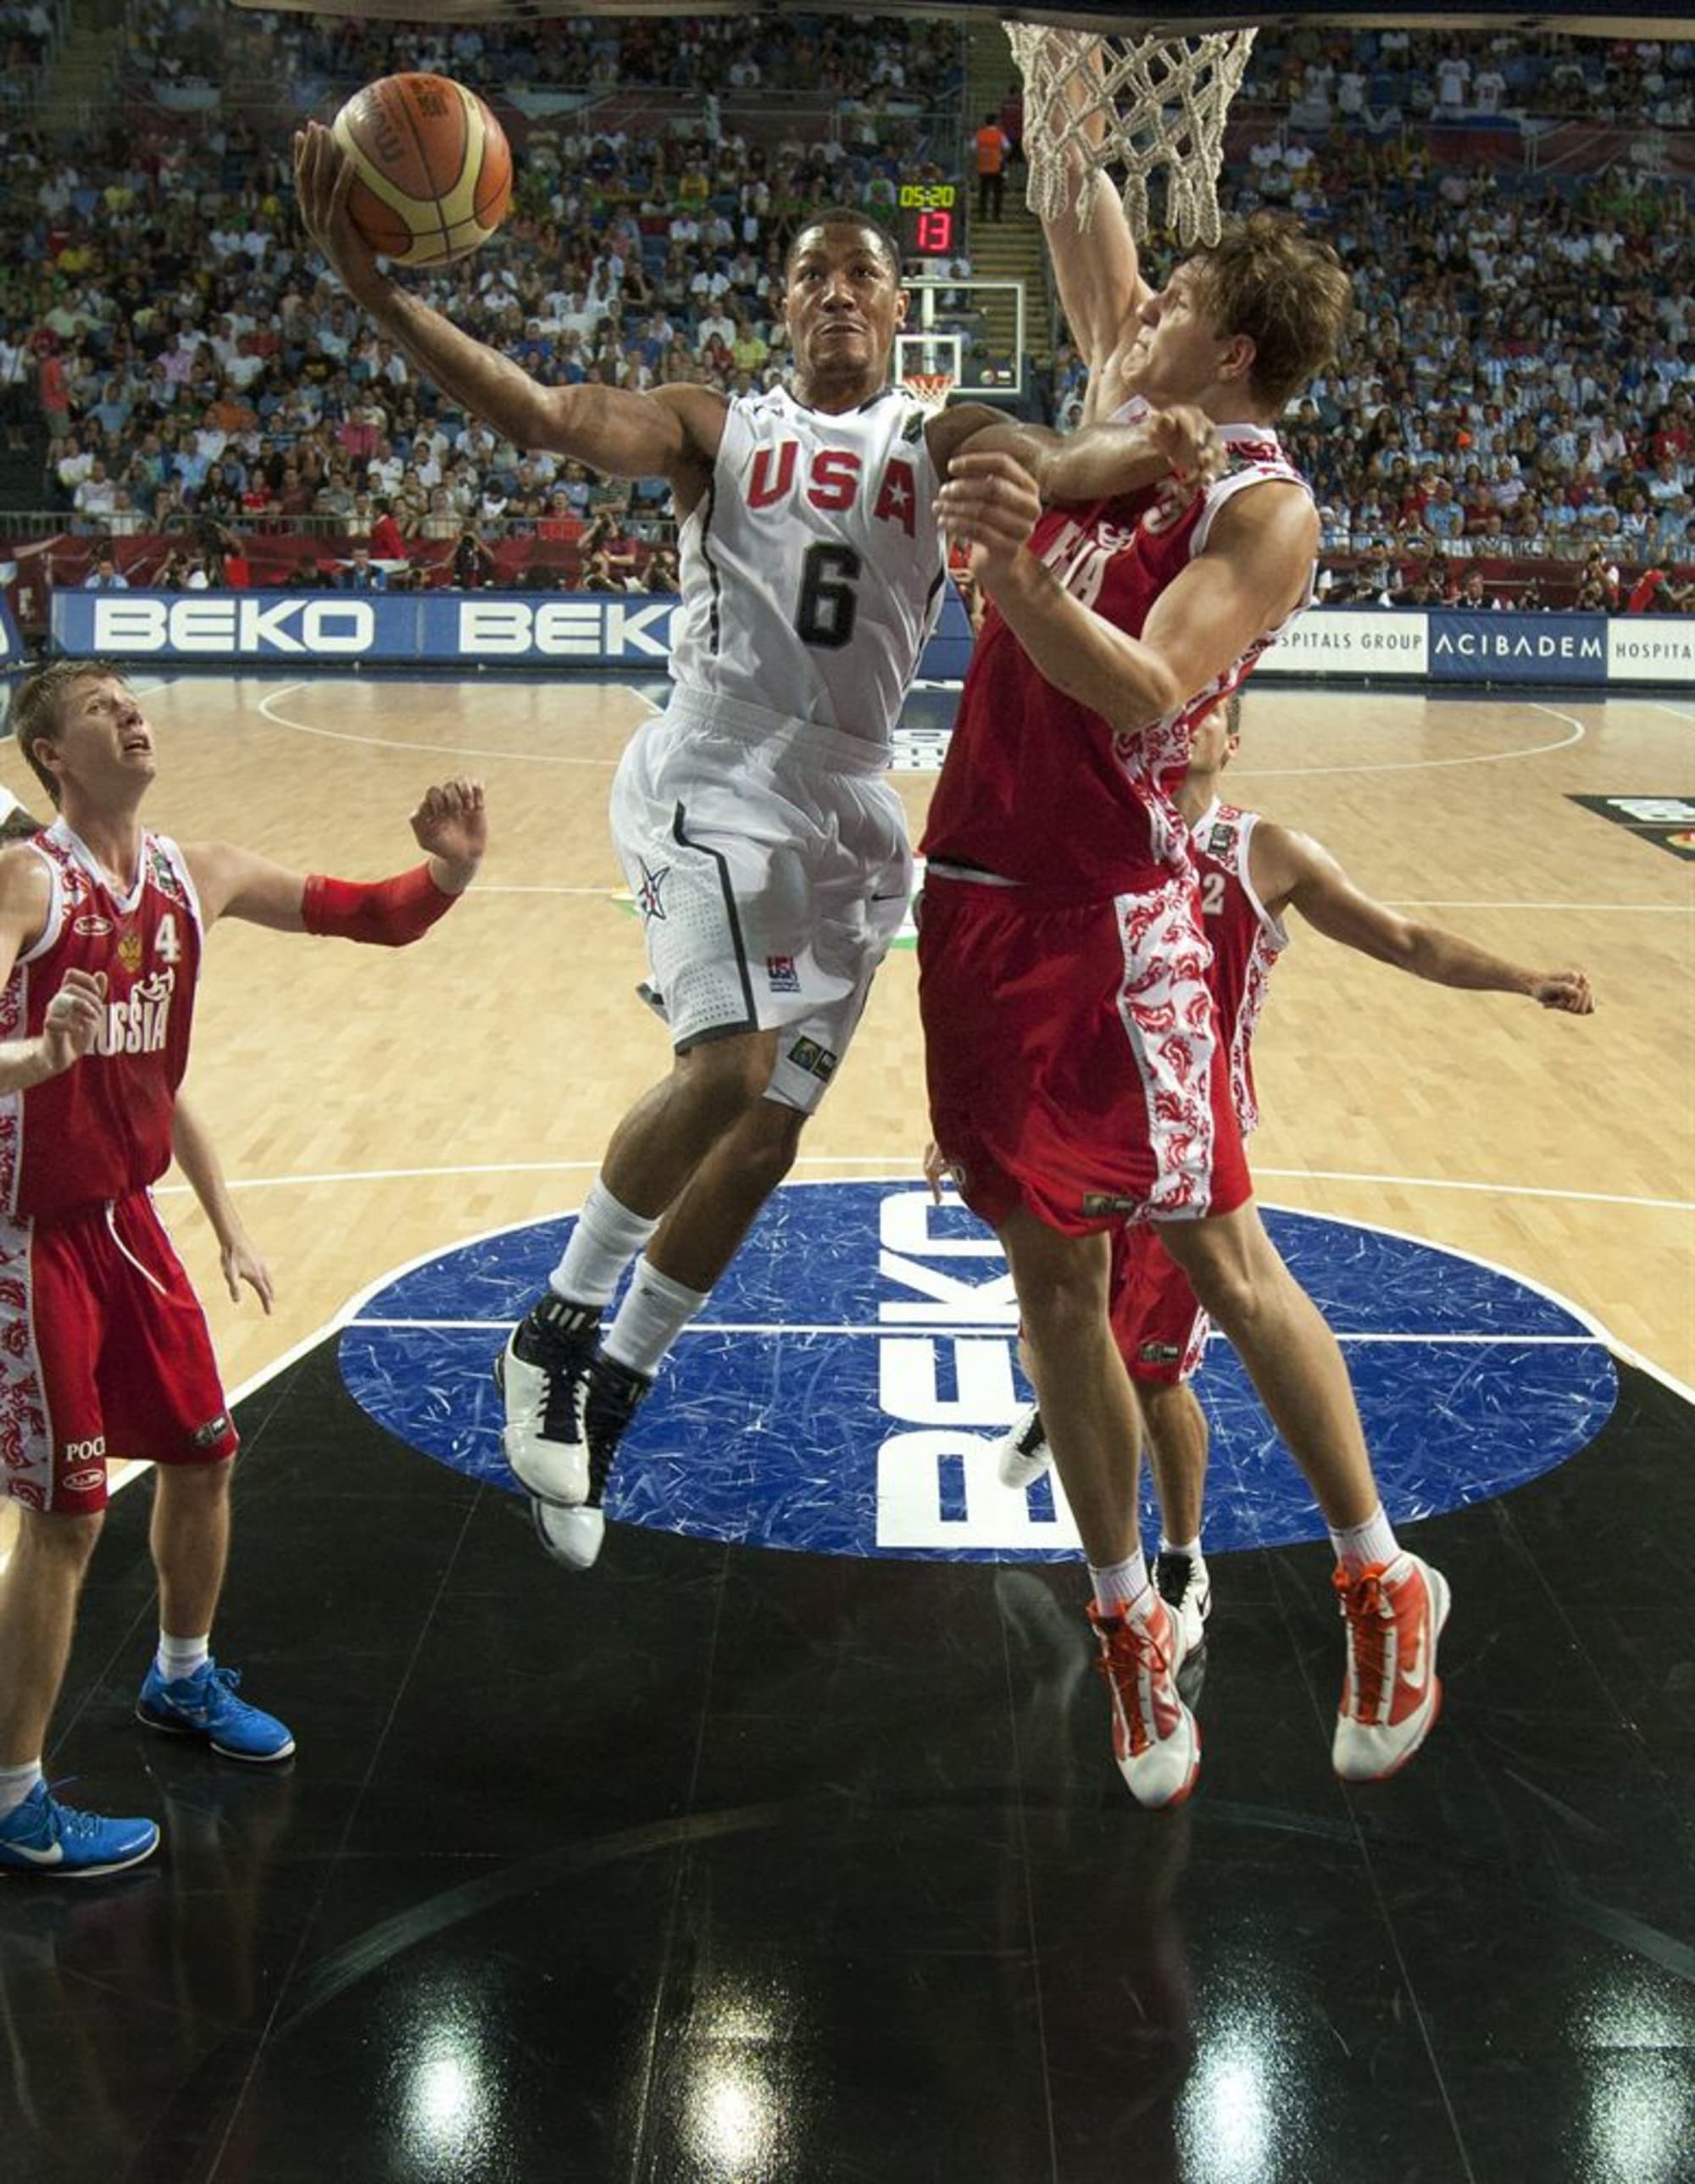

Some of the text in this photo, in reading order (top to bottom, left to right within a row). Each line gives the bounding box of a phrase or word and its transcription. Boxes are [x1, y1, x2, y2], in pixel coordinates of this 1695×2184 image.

[899, 185, 955, 208] 05:20
[918, 212, 952, 252] 13
[746, 440, 916, 538] USA
[795, 540, 862, 649] 6
[94, 598, 375, 652] BEKO
[1360, 633, 1423, 650] GROUP
[1435, 633, 1602, 658] ACIBADEM
[1616, 642, 1692, 659] HOSPITA
[154, 913, 181, 963] 4
[86, 986, 171, 1056] USSIA
